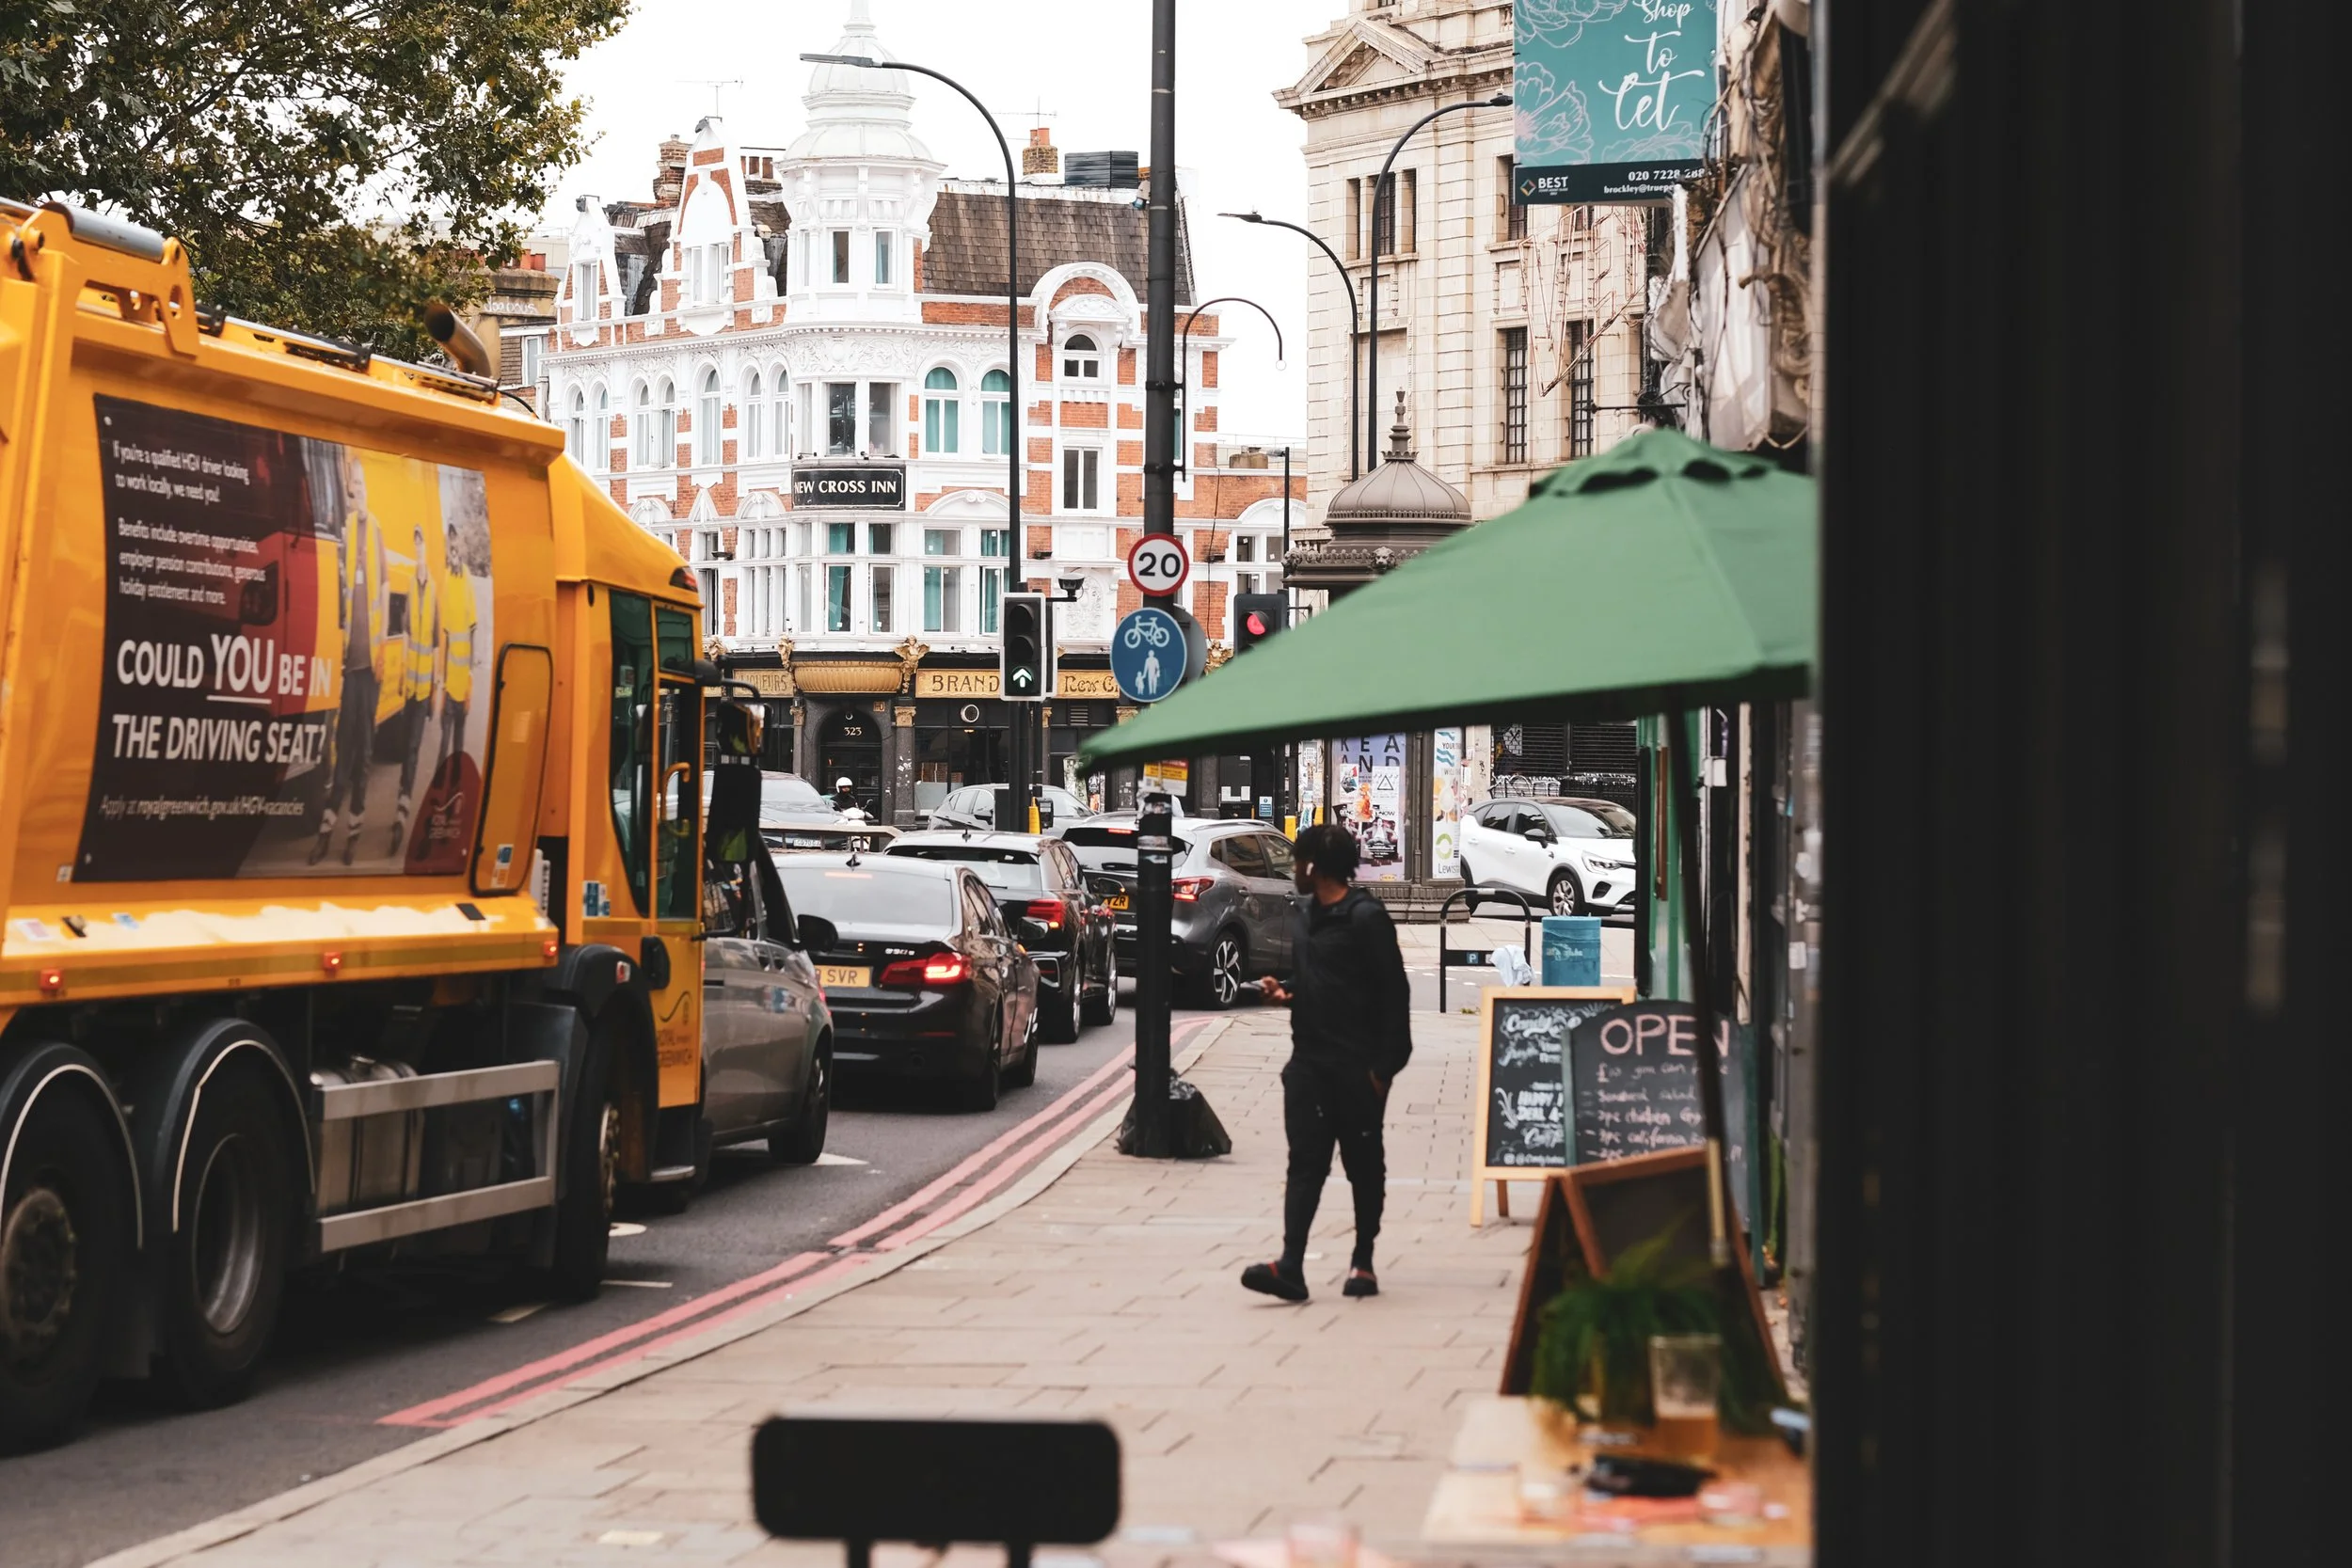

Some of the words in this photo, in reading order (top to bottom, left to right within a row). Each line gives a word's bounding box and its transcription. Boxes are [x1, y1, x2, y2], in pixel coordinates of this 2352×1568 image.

[1632, 0, 1694, 29] Shop
[1624, 31, 1681, 74] to
[1538, 177, 1568, 189] BEST
[1628, 170, 1650, 182] 020
[1653, 169, 1680, 181] 7228
[151, 450, 182, 469] qualified
[183, 453, 200, 471] HGV
[201, 457, 222, 475] driver
[223, 460, 250, 485] looking
[115, 474, 126, 488] to
[126, 474, 147, 490] work
[148, 474, 173, 499] locally,
[173, 483, 185, 498] we
[185, 483, 203, 500] need
[794, 480, 815, 495] NEW
[818, 480, 866, 494] CROSS
[870, 480, 898, 494] INN
[118, 517, 150, 539] Benefits
[151, 522, 177, 543] include
[178, 530, 211, 547] overtime
[119, 549, 154, 573] employer
[155, 555, 184, 574] pension
[234, 566, 266, 584] generous
[1138, 551, 1182, 579] 20
[119, 577, 146, 601] holiday
[190, 585, 204, 602] and
[117, 639, 205, 689] COULD
[210, 633, 275, 694] YOU
[278, 654, 306, 696] BE
[309, 657, 332, 698] IN
[1064, 674, 1100, 694] New
[112, 713, 163, 759] THE
[165, 716, 262, 763] DRIVING
[264, 721, 327, 765] SEAT?
[844, 726, 863, 736] 323
[99, 794, 125, 821] Apply
[126, 799, 138, 816] at
[1469, 953, 1477, 964] P
[827, 969, 858, 985] SVR
[1600, 1014, 1730, 1057] OPEN
